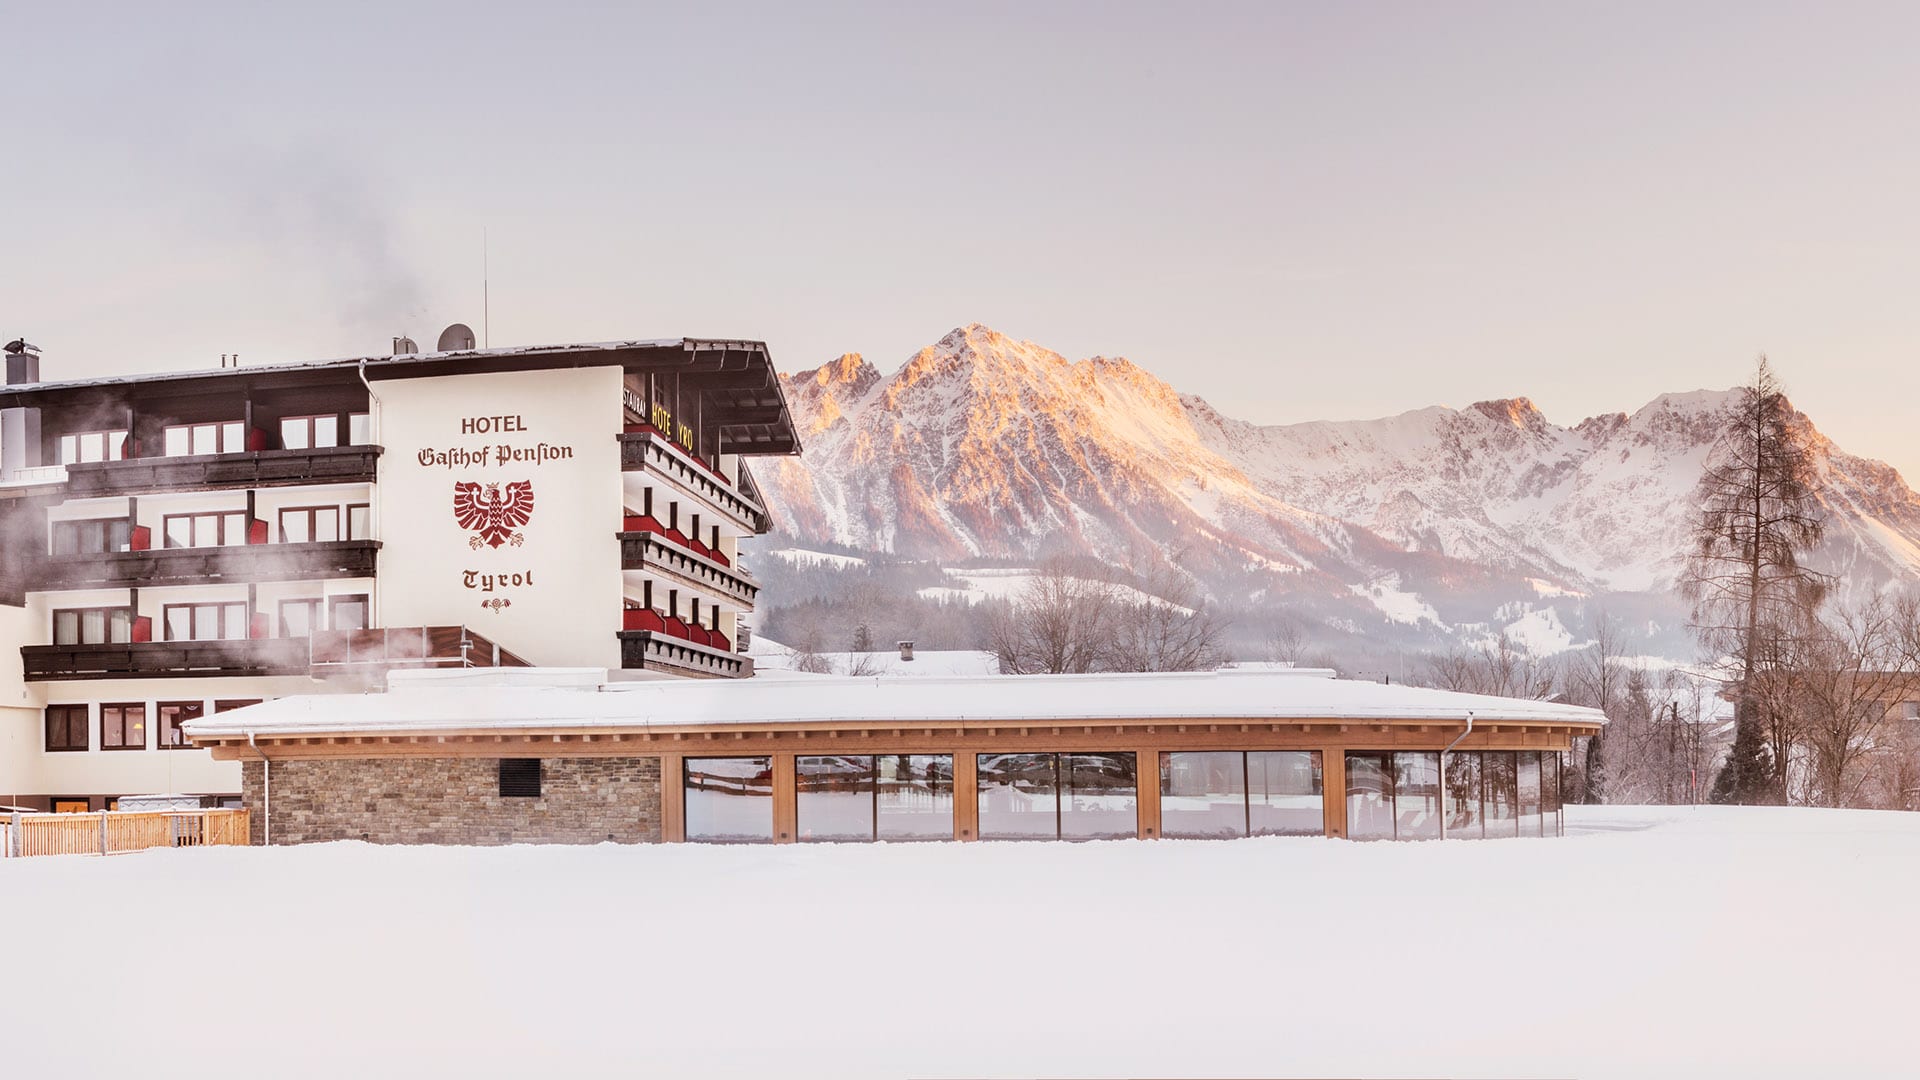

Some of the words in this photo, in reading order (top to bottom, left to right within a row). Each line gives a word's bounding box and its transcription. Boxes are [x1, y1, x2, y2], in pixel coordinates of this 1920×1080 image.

[461, 415, 528, 434] HOTEL
[652, 401, 671, 436] HOTE
[678, 421, 693, 451] YRO
[462, 569, 534, 593] Tyrol
